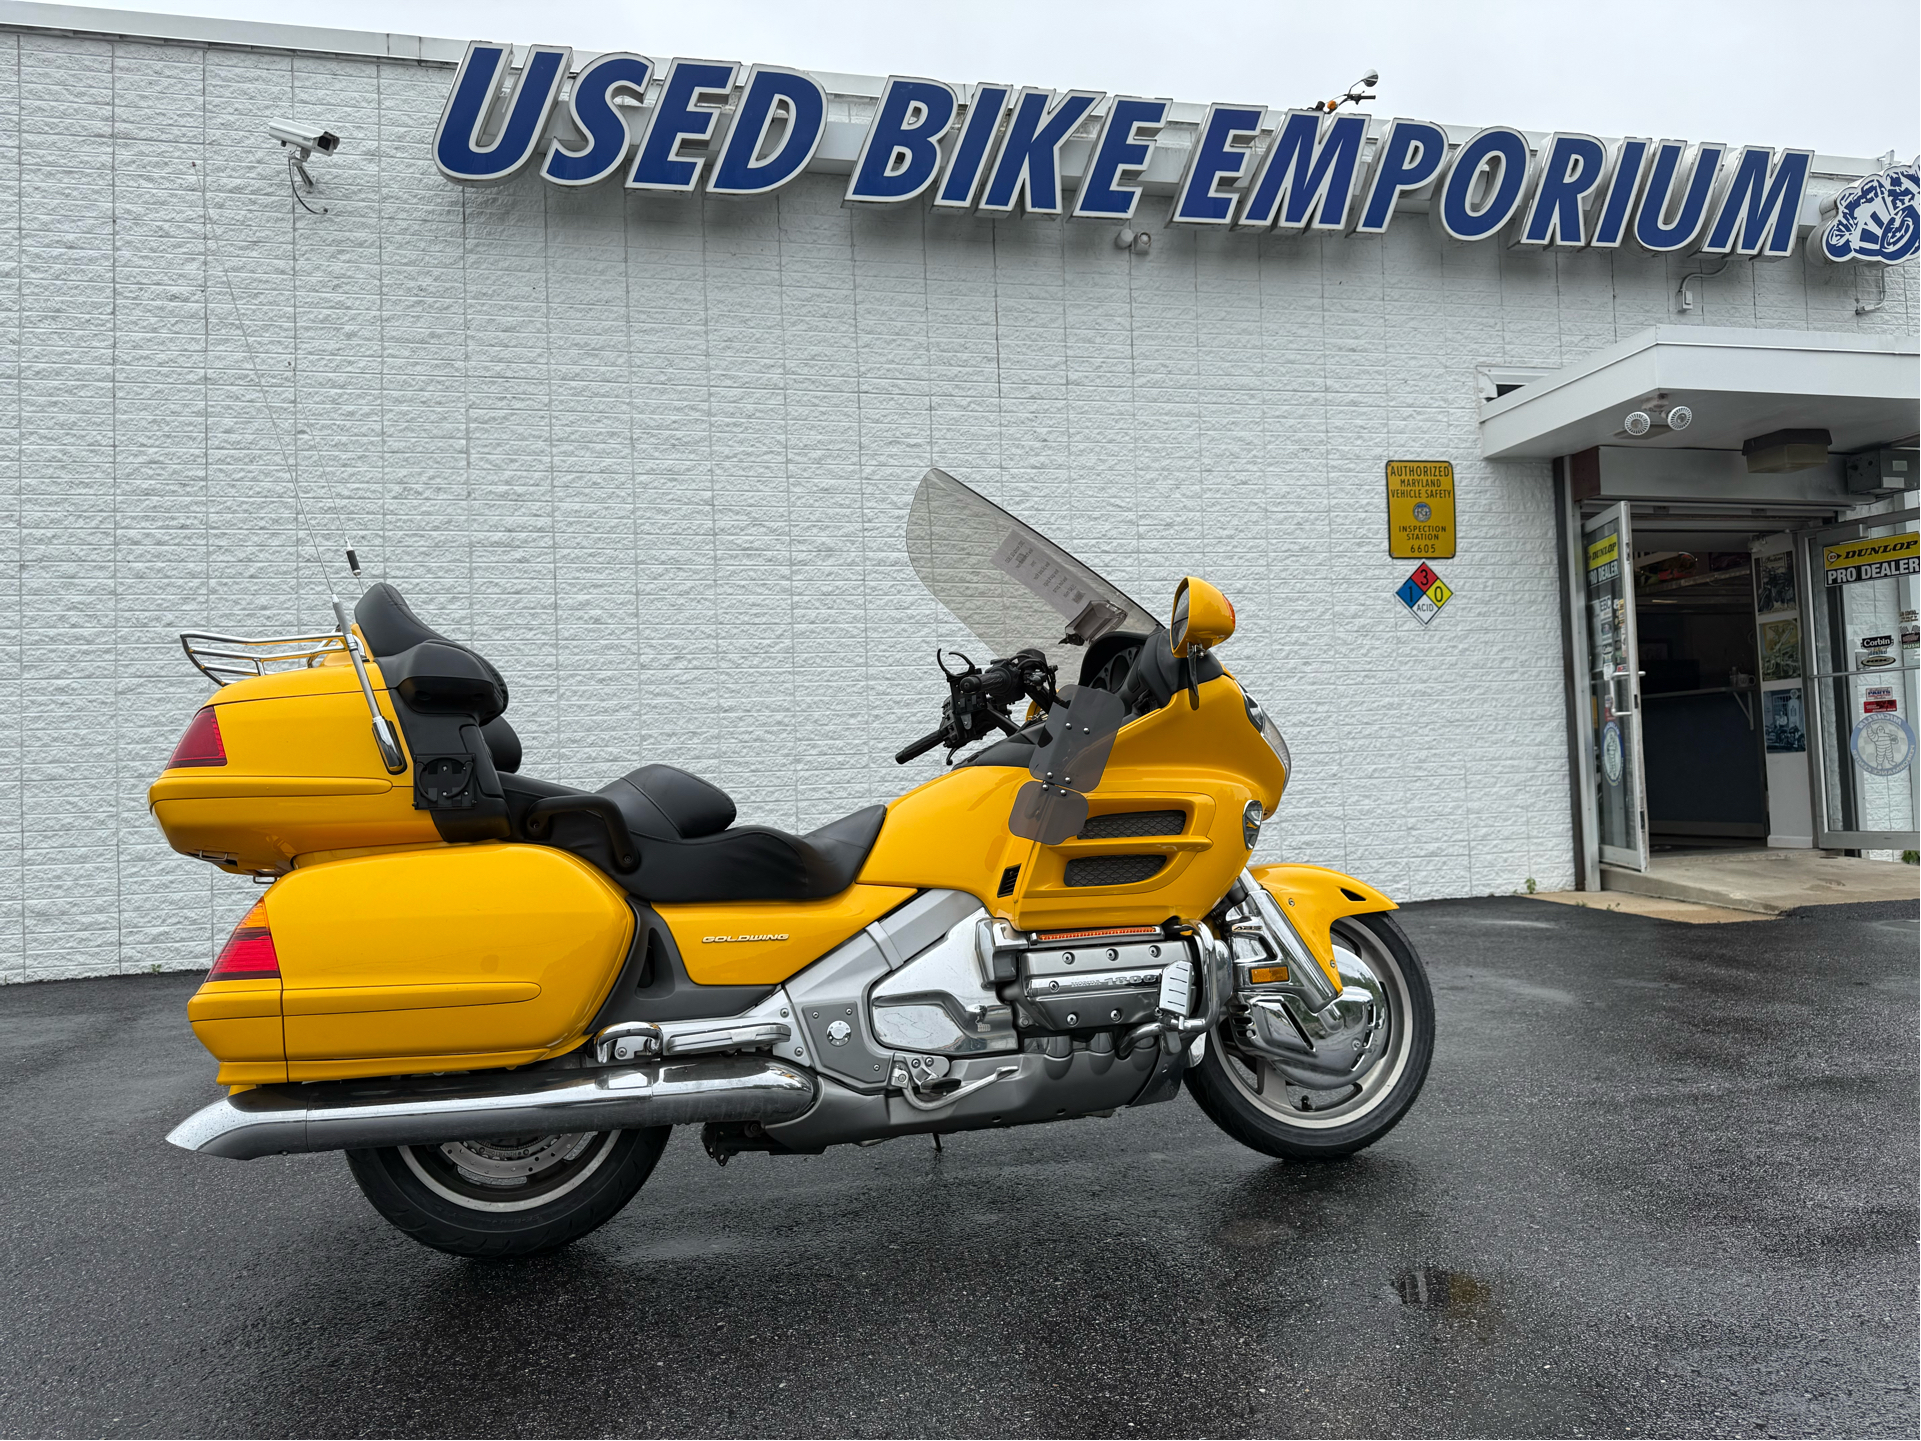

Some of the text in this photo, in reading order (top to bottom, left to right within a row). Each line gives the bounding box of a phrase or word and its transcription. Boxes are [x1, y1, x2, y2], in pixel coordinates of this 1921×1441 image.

[432, 40, 1815, 257] USED BIKE EMPORIUM
[1390, 465, 1450, 478] AUTHORIZED
[1400, 478, 1442, 488] MARYLAND
[1390, 489, 1452, 499] VEHICLE SAFETY
[1398, 525, 1447, 533] INSPECTION
[1406, 533, 1440, 541] STATION
[1410, 544, 1436, 554] 6605
[1592, 542, 1617, 560] DUNLOP
[1843, 540, 1918, 560] DUNLOP
[1828, 557, 1920, 585] PRO DEALER
[1420, 568, 1429, 586] 3
[1408, 586, 1413, 603] 1
[1434, 586, 1444, 603] 0
[1416, 603, 1434, 612] ACID
[1863, 637, 1890, 647] Corbin
[702, 933, 790, 943] GOLDWING
